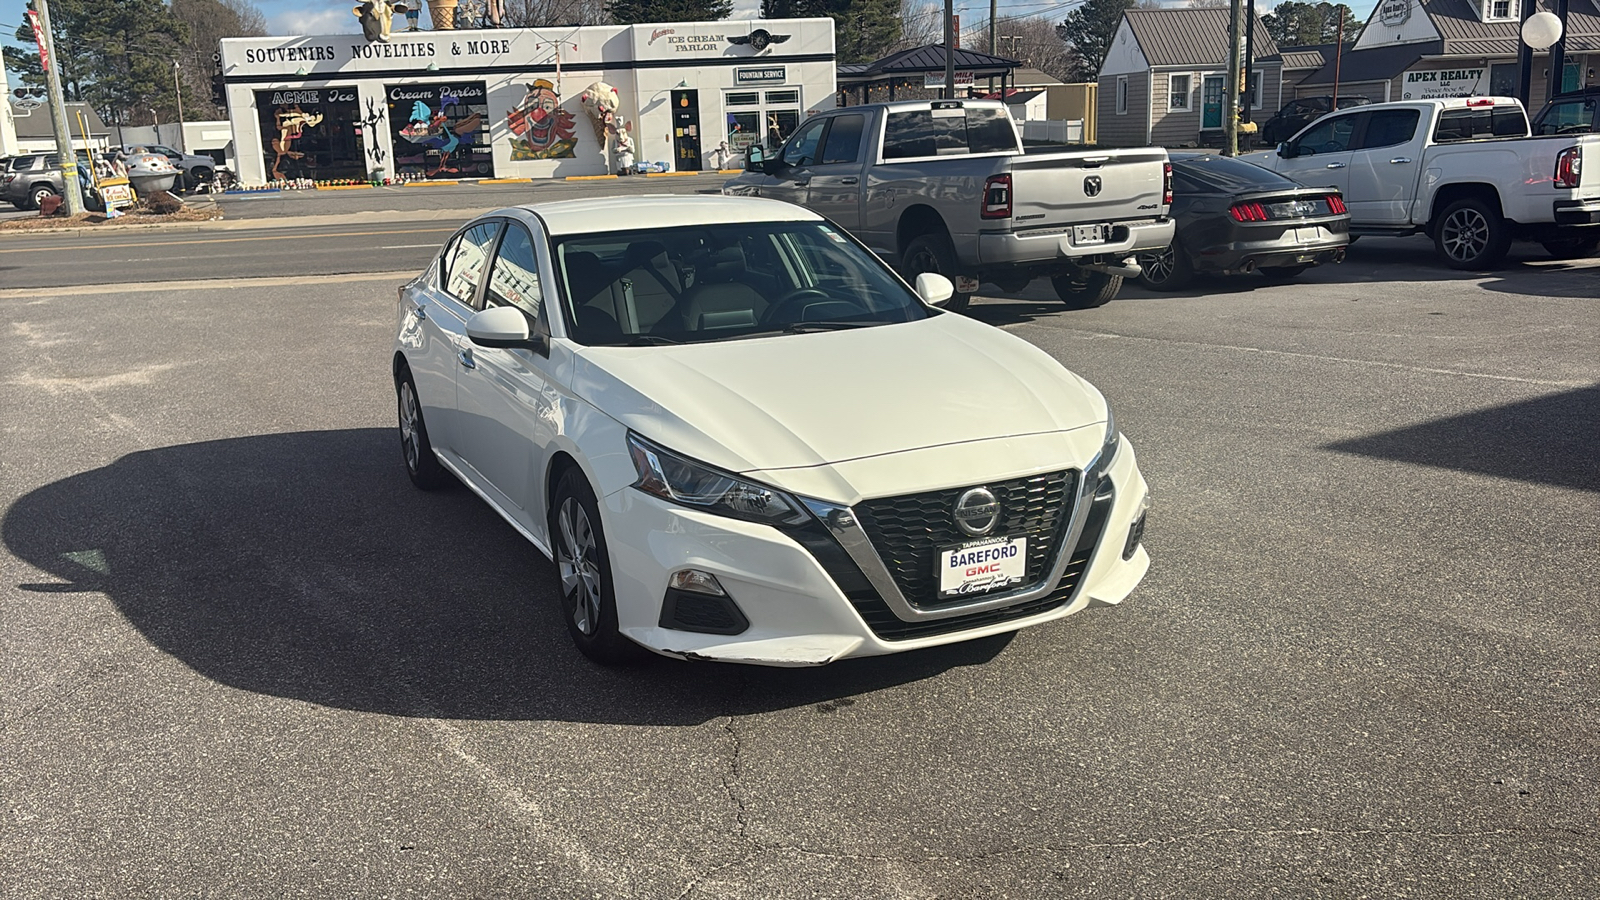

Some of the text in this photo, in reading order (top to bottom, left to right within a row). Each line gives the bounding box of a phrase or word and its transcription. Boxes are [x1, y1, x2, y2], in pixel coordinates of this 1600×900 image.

[667, 34, 725, 44] ICE CREAM
[246, 39, 510, 64] SOUVENIRS NOVELTIES & MORE
[675, 43, 718, 52] PARLOR
[739, 69, 784, 80] FOUNTAIN SERVICE
[1407, 69, 1483, 83] APEX REALTY
[272, 89, 356, 105] ACME Ice
[390, 86, 483, 101] Cream Parlor
[960, 505, 997, 518] NISSAN
[962, 535, 1009, 549] TAPPAHANNOCK
[950, 545, 1018, 568] BAREFORD
[965, 563, 1001, 577] GMC
[958, 576, 1011, 593] Bareford
